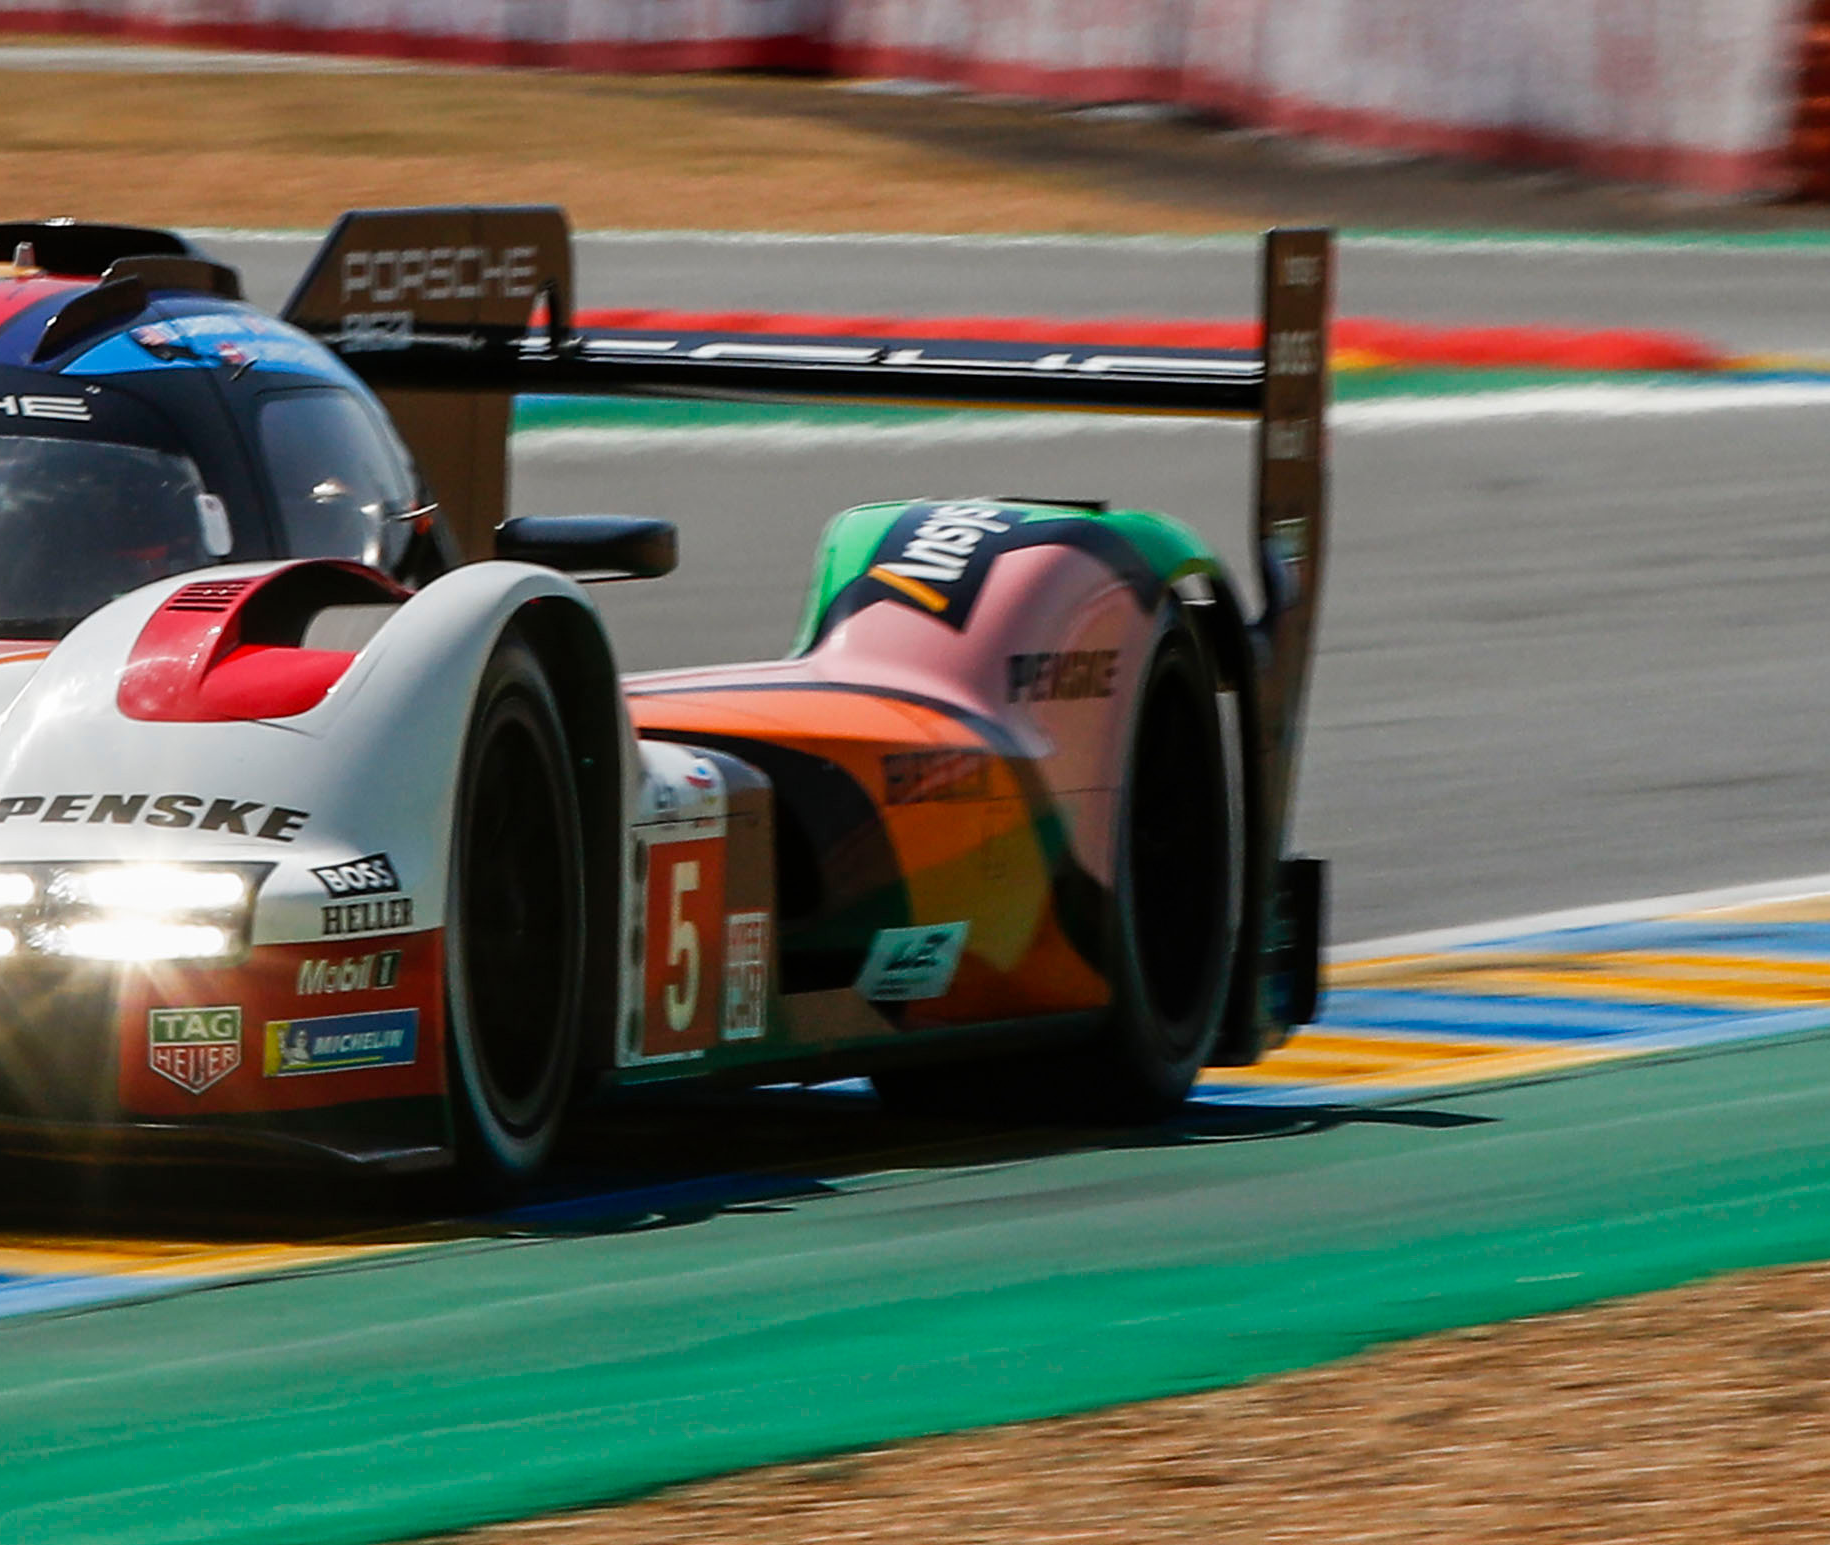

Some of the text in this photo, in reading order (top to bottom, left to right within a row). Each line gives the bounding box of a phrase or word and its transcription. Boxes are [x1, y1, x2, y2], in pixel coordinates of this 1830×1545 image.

[342, 245, 538, 302] PORSCHE
[316, 858, 394, 894] BOSS
[321, 898, 414, 935] HELLER
[664, 860, 701, 1032] 5
[297, 953, 375, 995] Mobil
[156, 1010, 233, 1039] TAG
[313, 1028, 405, 1056] MICHELIN
[154, 1044, 239, 1085] HEUER
